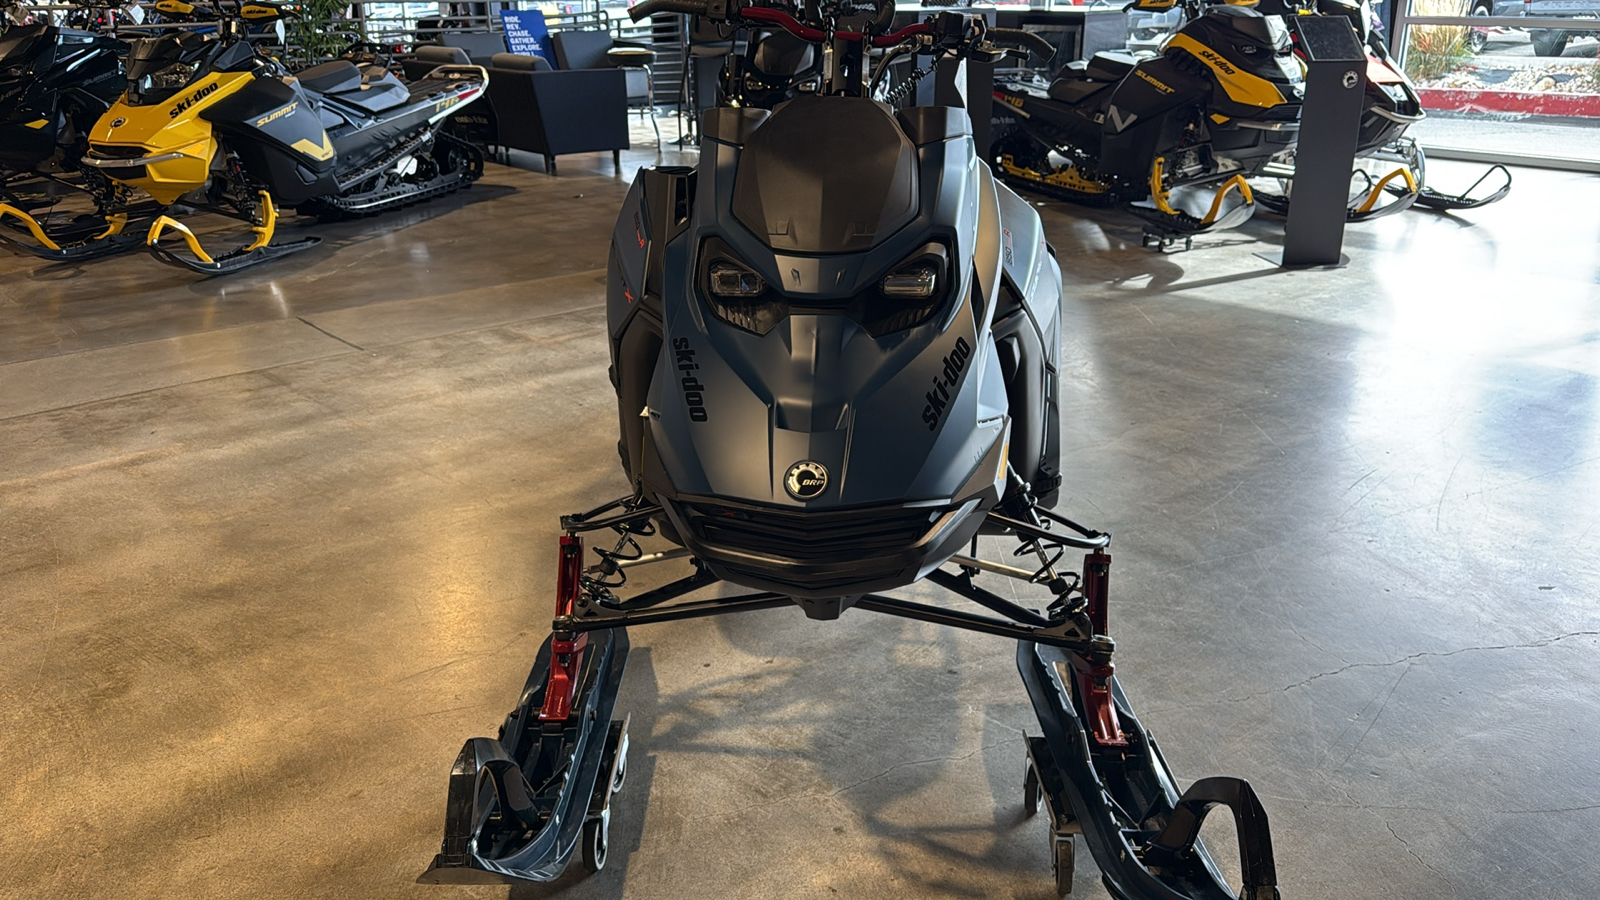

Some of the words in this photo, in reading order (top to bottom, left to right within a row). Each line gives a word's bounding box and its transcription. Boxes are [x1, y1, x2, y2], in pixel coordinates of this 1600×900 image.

[1200, 50, 1235, 75] ski-doo
[1135, 69, 1175, 94] SUMMIT
[169, 82, 218, 118] ski-doo
[257, 101, 298, 127] SUMMIT
[1005, 246, 1013, 265] 850
[672, 337, 708, 422] ski-doo
[921, 336, 970, 431] ski-doo
